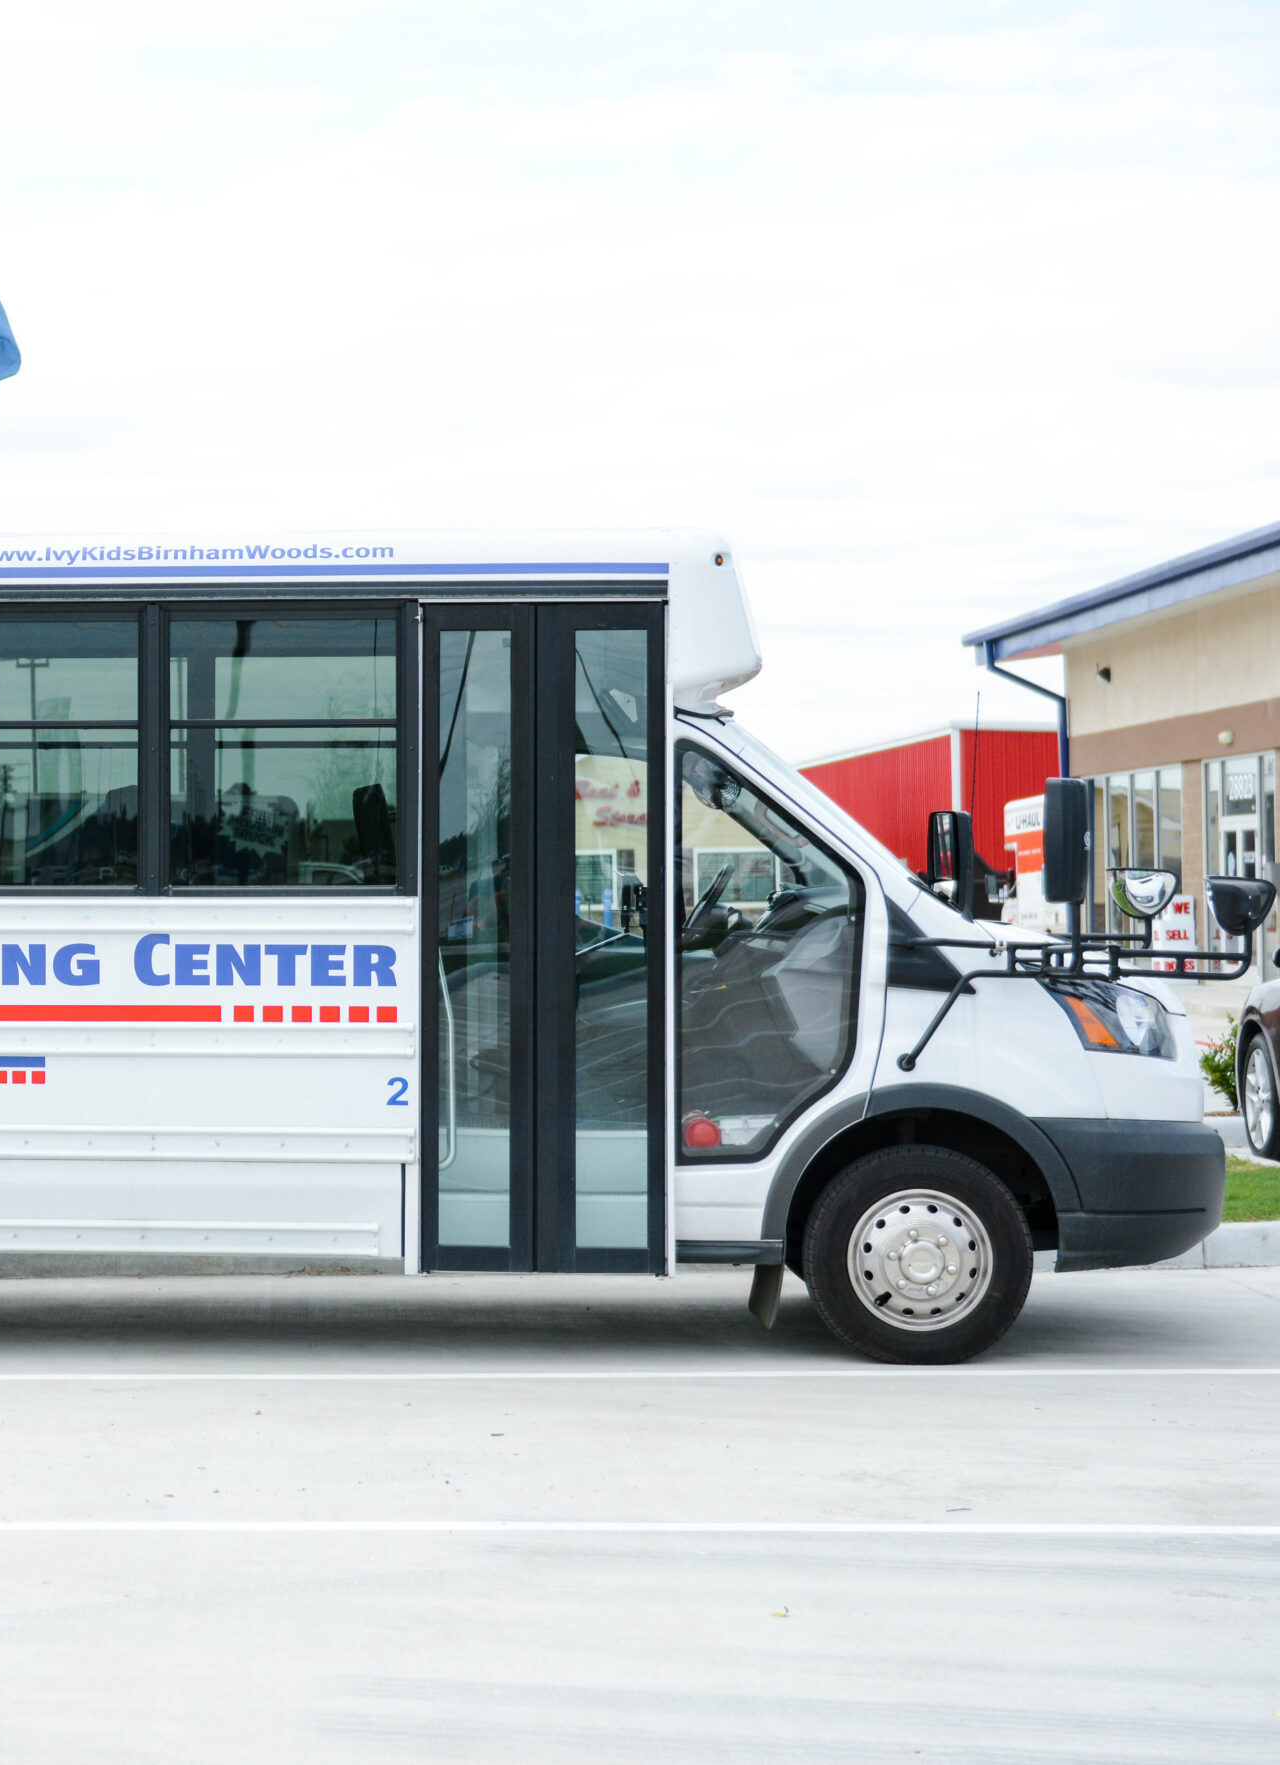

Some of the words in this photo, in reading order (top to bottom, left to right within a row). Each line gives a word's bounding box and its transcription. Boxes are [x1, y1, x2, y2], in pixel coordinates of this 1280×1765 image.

[1229, 774, 1253, 800] 28823
[1015, 811, 1041, 830] U-HAUL
[1172, 902, 1190, 914] WE
[1165, 929, 1189, 940] SELL
[1164, 961, 1195, 971] BOES
[386, 1077, 409, 1106] 2
